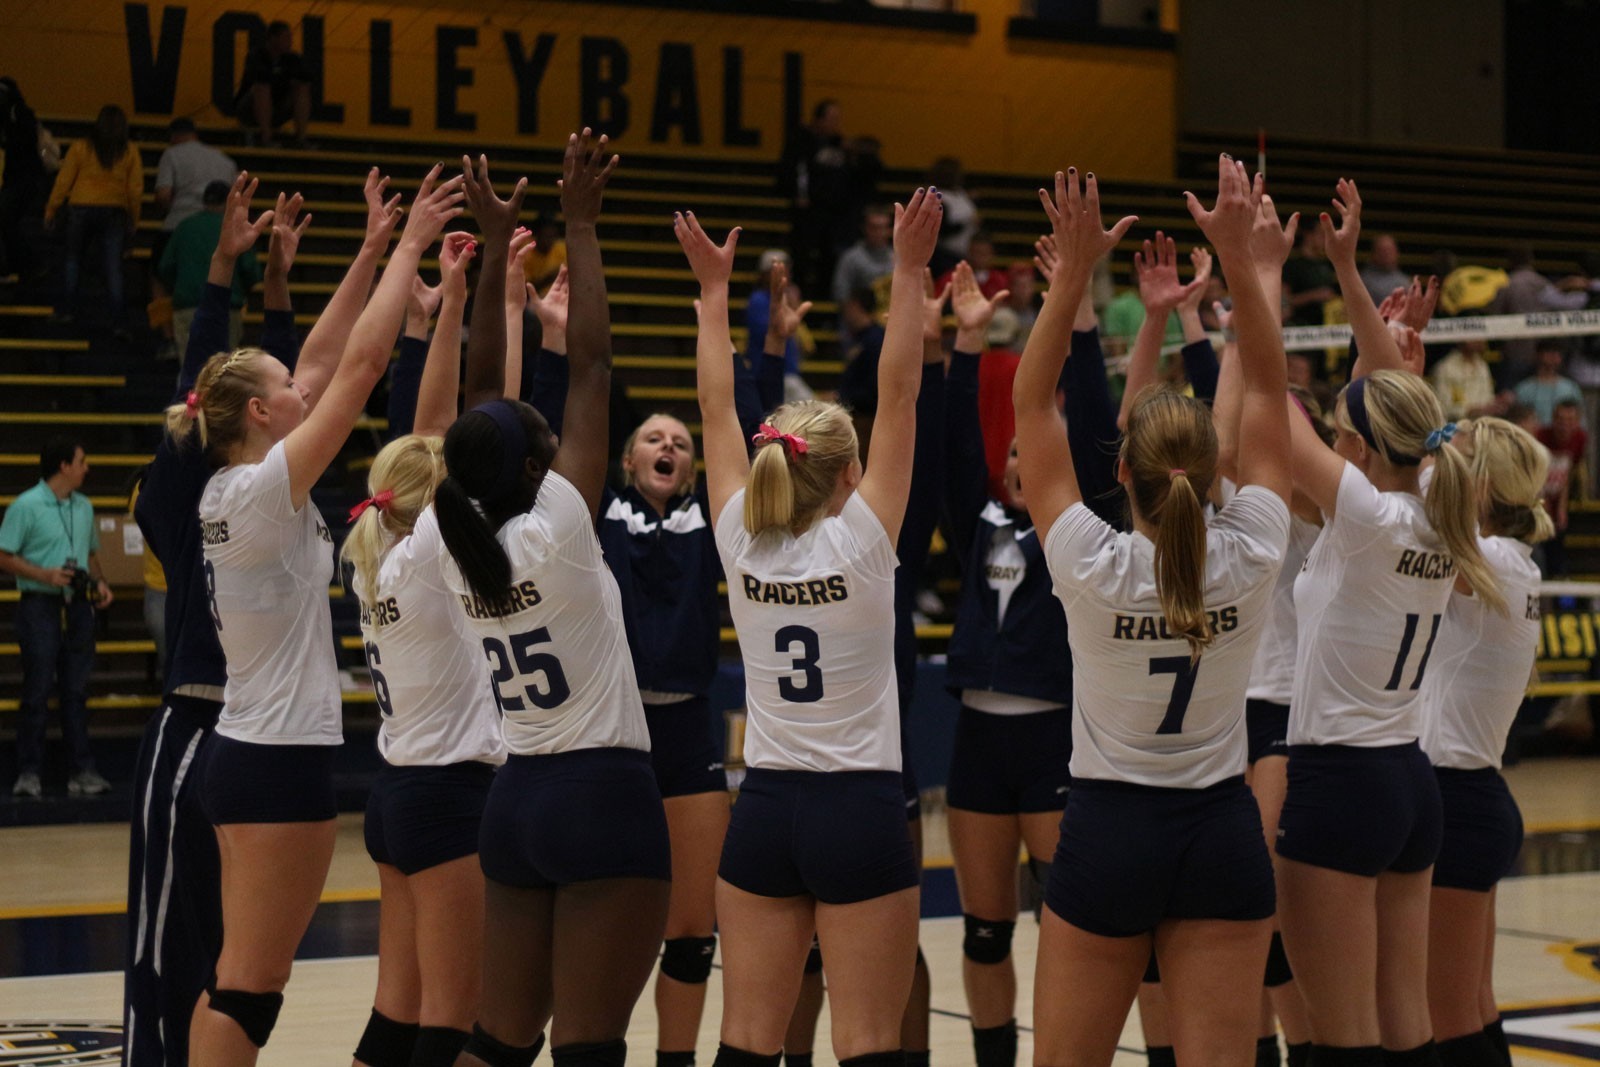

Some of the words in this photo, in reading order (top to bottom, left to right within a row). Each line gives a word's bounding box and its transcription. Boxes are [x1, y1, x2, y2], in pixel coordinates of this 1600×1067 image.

[124, 4, 805, 150] VOLLEYBALL
[742, 574, 848, 606] RACERS
[1395, 549, 1457, 580] RACER
[365, 640, 393, 716] 6
[482, 626, 571, 711] 25
[775, 625, 824, 703] 3
[1384, 613, 1442, 691] 11
[1149, 654, 1202, 735] 7
